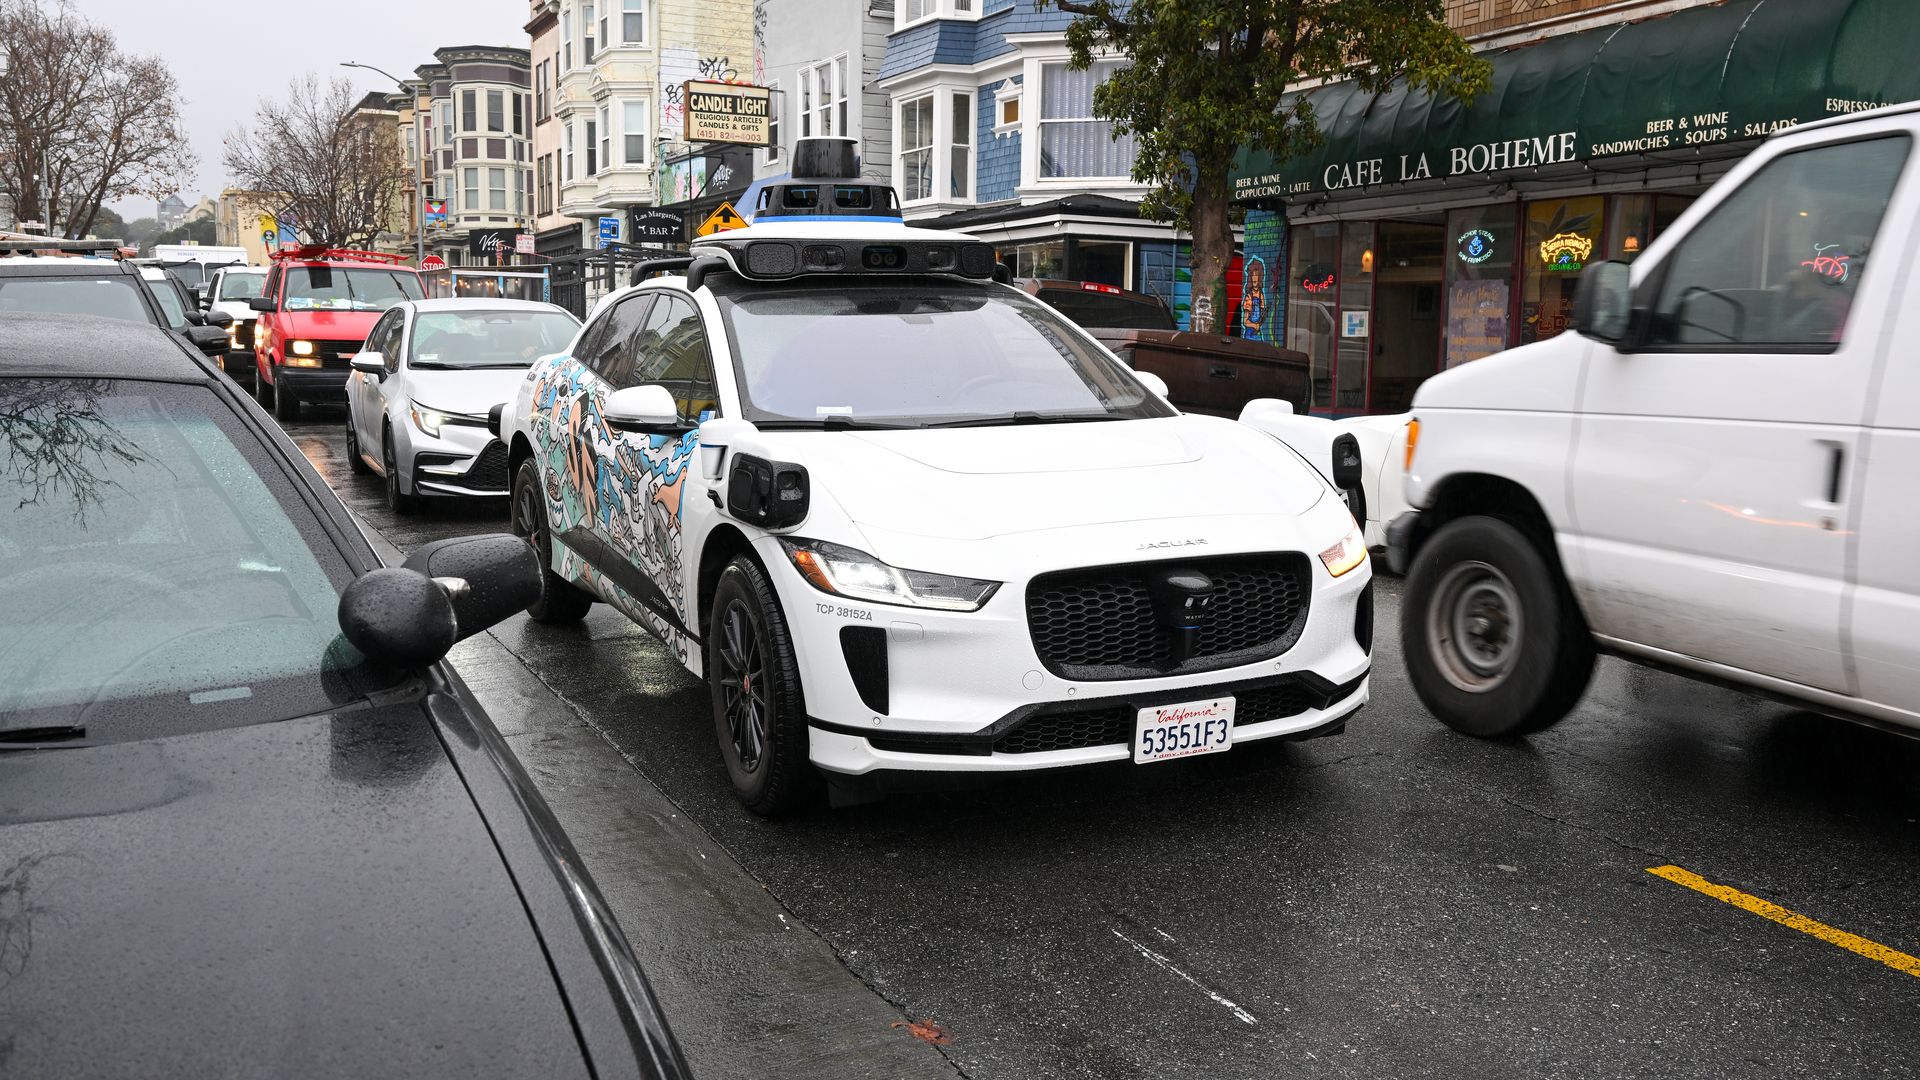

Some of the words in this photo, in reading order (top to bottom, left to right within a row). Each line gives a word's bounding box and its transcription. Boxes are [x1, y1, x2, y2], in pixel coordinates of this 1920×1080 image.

[690, 94, 733, 113] CANDLE
[736, 97, 767, 116] LIGHT
[1826, 98, 1877, 113] ESPRESSO
[695, 113, 730, 122] RELIGIOUS
[733, 116, 763, 124] ARTICLES
[698, 121, 729, 130] CANDLES
[1646, 118, 1674, 134] BEER
[1678, 117, 1689, 129] &
[1693, 111, 1729, 127] WINE
[696, 129, 716, 139] (415)
[1591, 134, 1669, 156] SANDWICHES
[1684, 127, 1728, 145] SOUPS
[1744, 117, 1798, 137] SALADS
[1323, 157, 1383, 190] CAFE
[1400, 152, 1432, 181] LA
[1450, 131, 1577, 175] BOHEME
[1236, 177, 1252, 188] BEER
[1253, 176, 1259, 185] &
[1261, 173, 1281, 184] WINE
[1235, 184, 1281, 200] CAPPUCCINO
[1289, 181, 1311, 193] LATTE
[634, 213, 648, 222] Las
[648, 210, 682, 223] Margaritas
[649, 227, 668, 235] BAR
[422, 262, 444, 271] STOP
[1136, 538, 1209, 550] JAGUAR
[816, 603, 835, 615] TCP
[836, 607, 873, 621] 38152A
[1157, 706, 1217, 724] California
[1142, 719, 1228, 755] 53551F3
[1158, 748, 1209, 759] dmv.ca.gov
